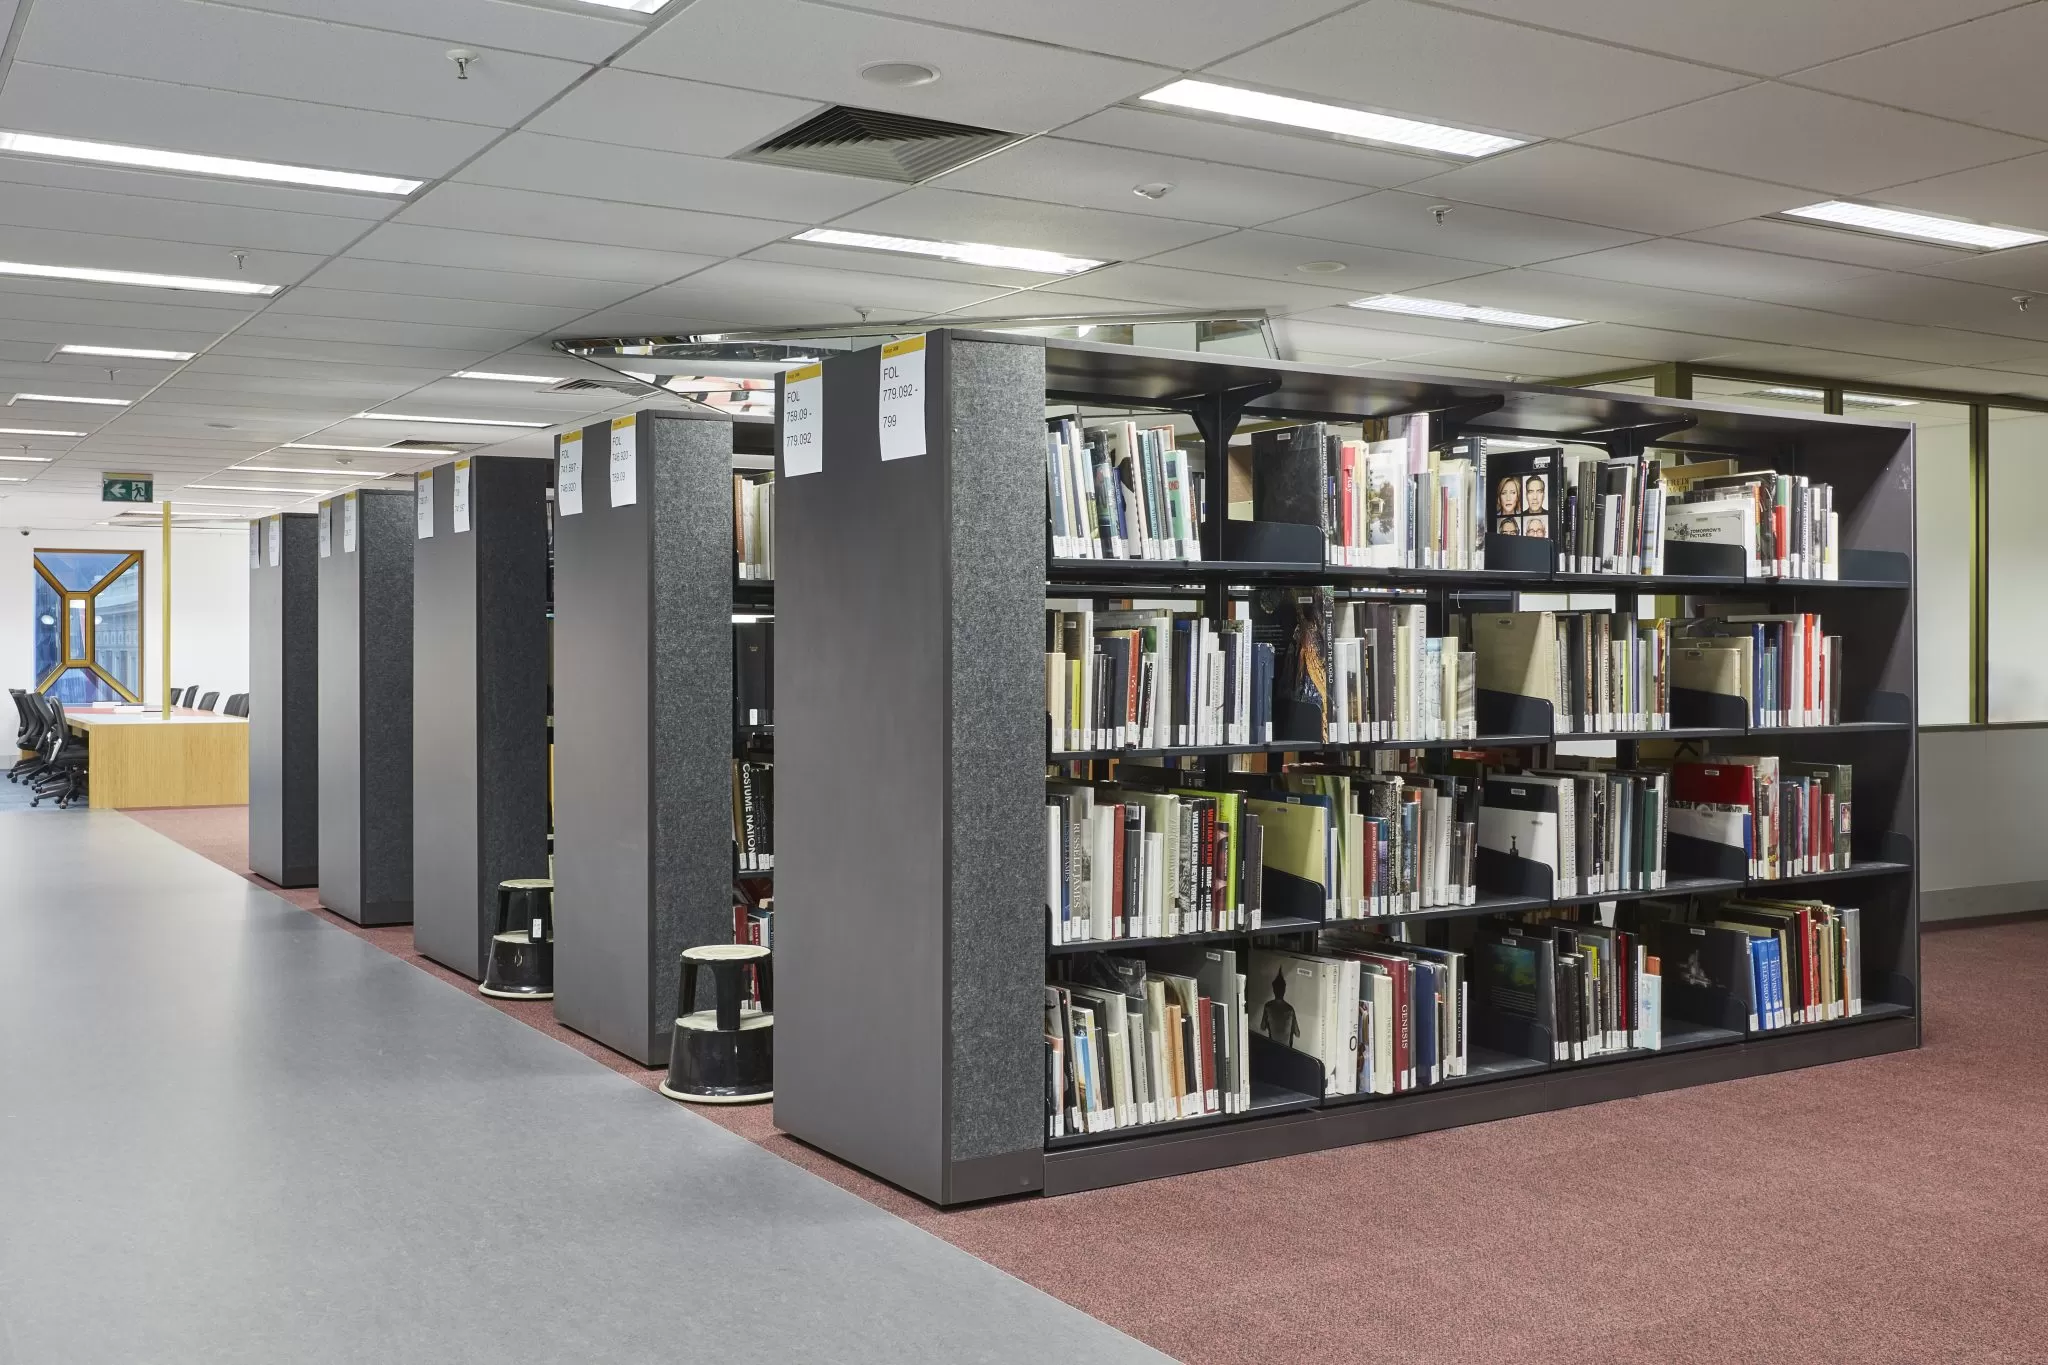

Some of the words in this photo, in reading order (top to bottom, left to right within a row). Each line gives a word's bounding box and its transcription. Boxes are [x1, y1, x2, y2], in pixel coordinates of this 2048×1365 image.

[883, 366, 899, 380] FOL
[787, 391, 800, 404] FOL
[883, 384, 913, 401] 779.092
[786, 407, 808, 422] 759.09
[883, 414, 897, 428] 799
[612, 436, 622, 446] FOL
[786, 432, 812, 447] 779.092
[1479, 437, 1487, 476] AFTERMATH
[1073, 823, 1081, 872] RUSSELL
[1073, 872, 1081, 908] JAMES
[1771, 958, 1779, 1002] TELEVISION
